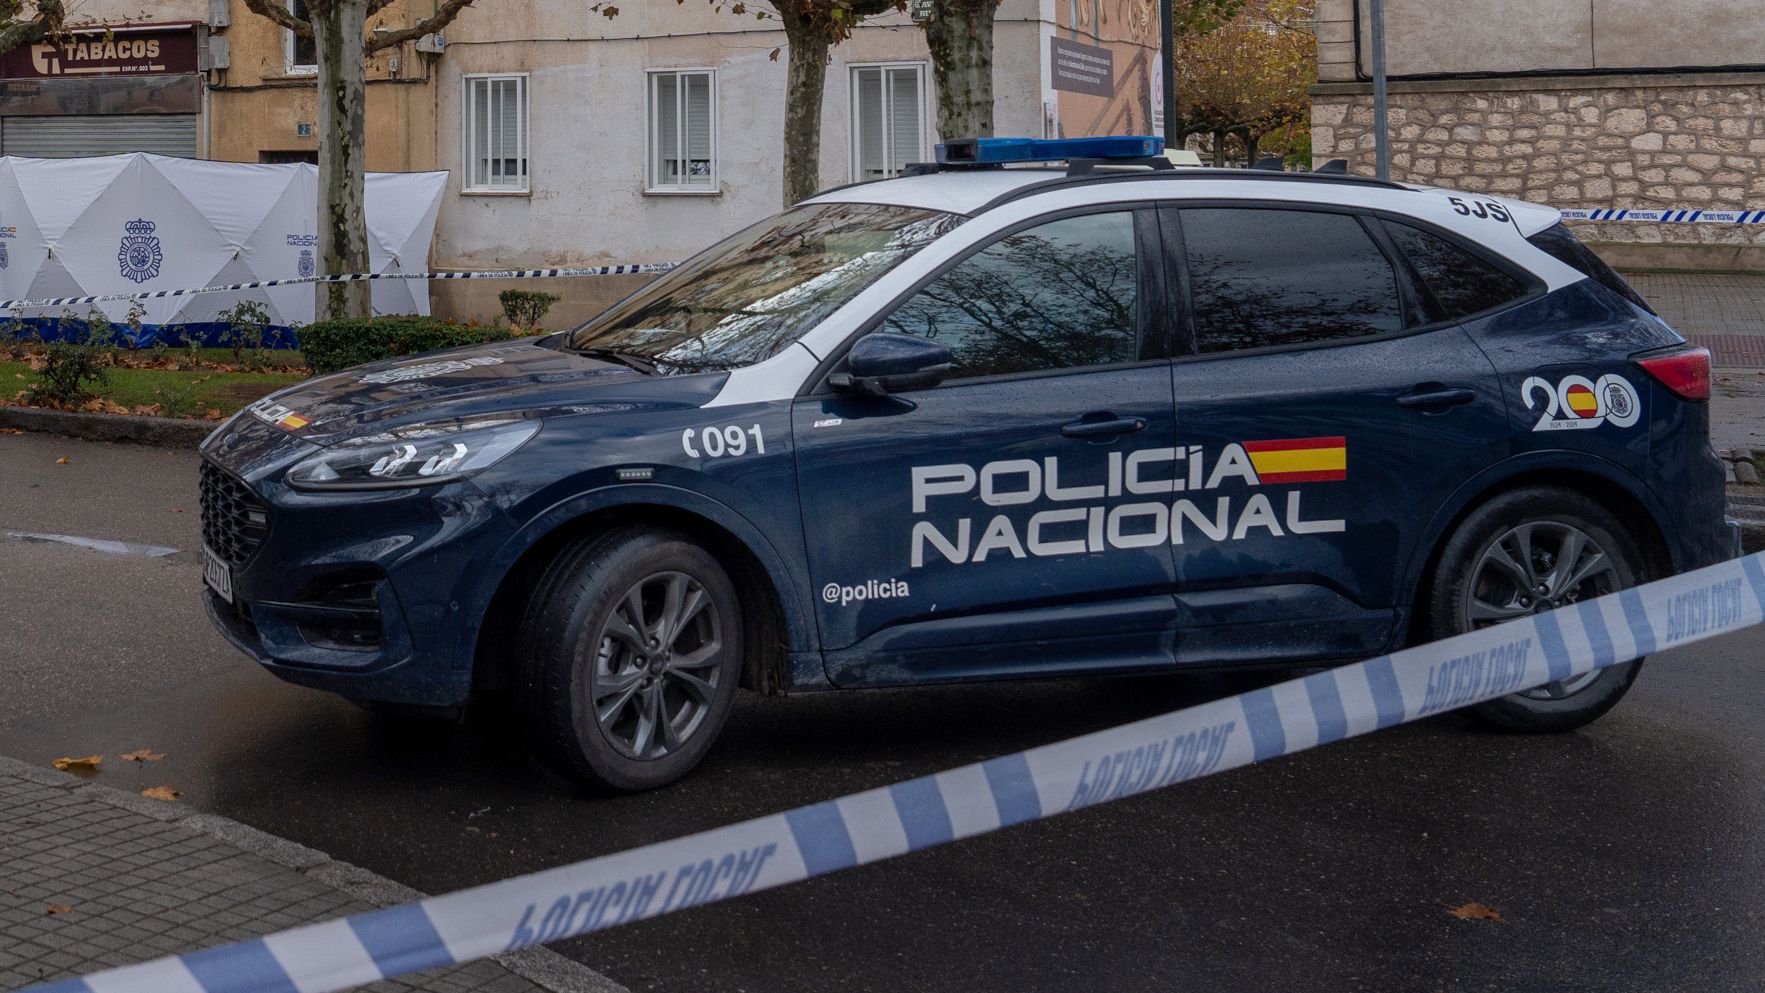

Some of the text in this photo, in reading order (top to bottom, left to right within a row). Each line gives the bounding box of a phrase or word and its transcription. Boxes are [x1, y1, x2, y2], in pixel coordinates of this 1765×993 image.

[65, 40, 160, 61] TABACOS
[1447, 196, 1510, 223] 5JS
[1521, 373, 1641, 432] 200
[702, 424, 765, 458] 091
[910, 491, 1346, 568] NACIONAL
[822, 578, 910, 606] @policia
